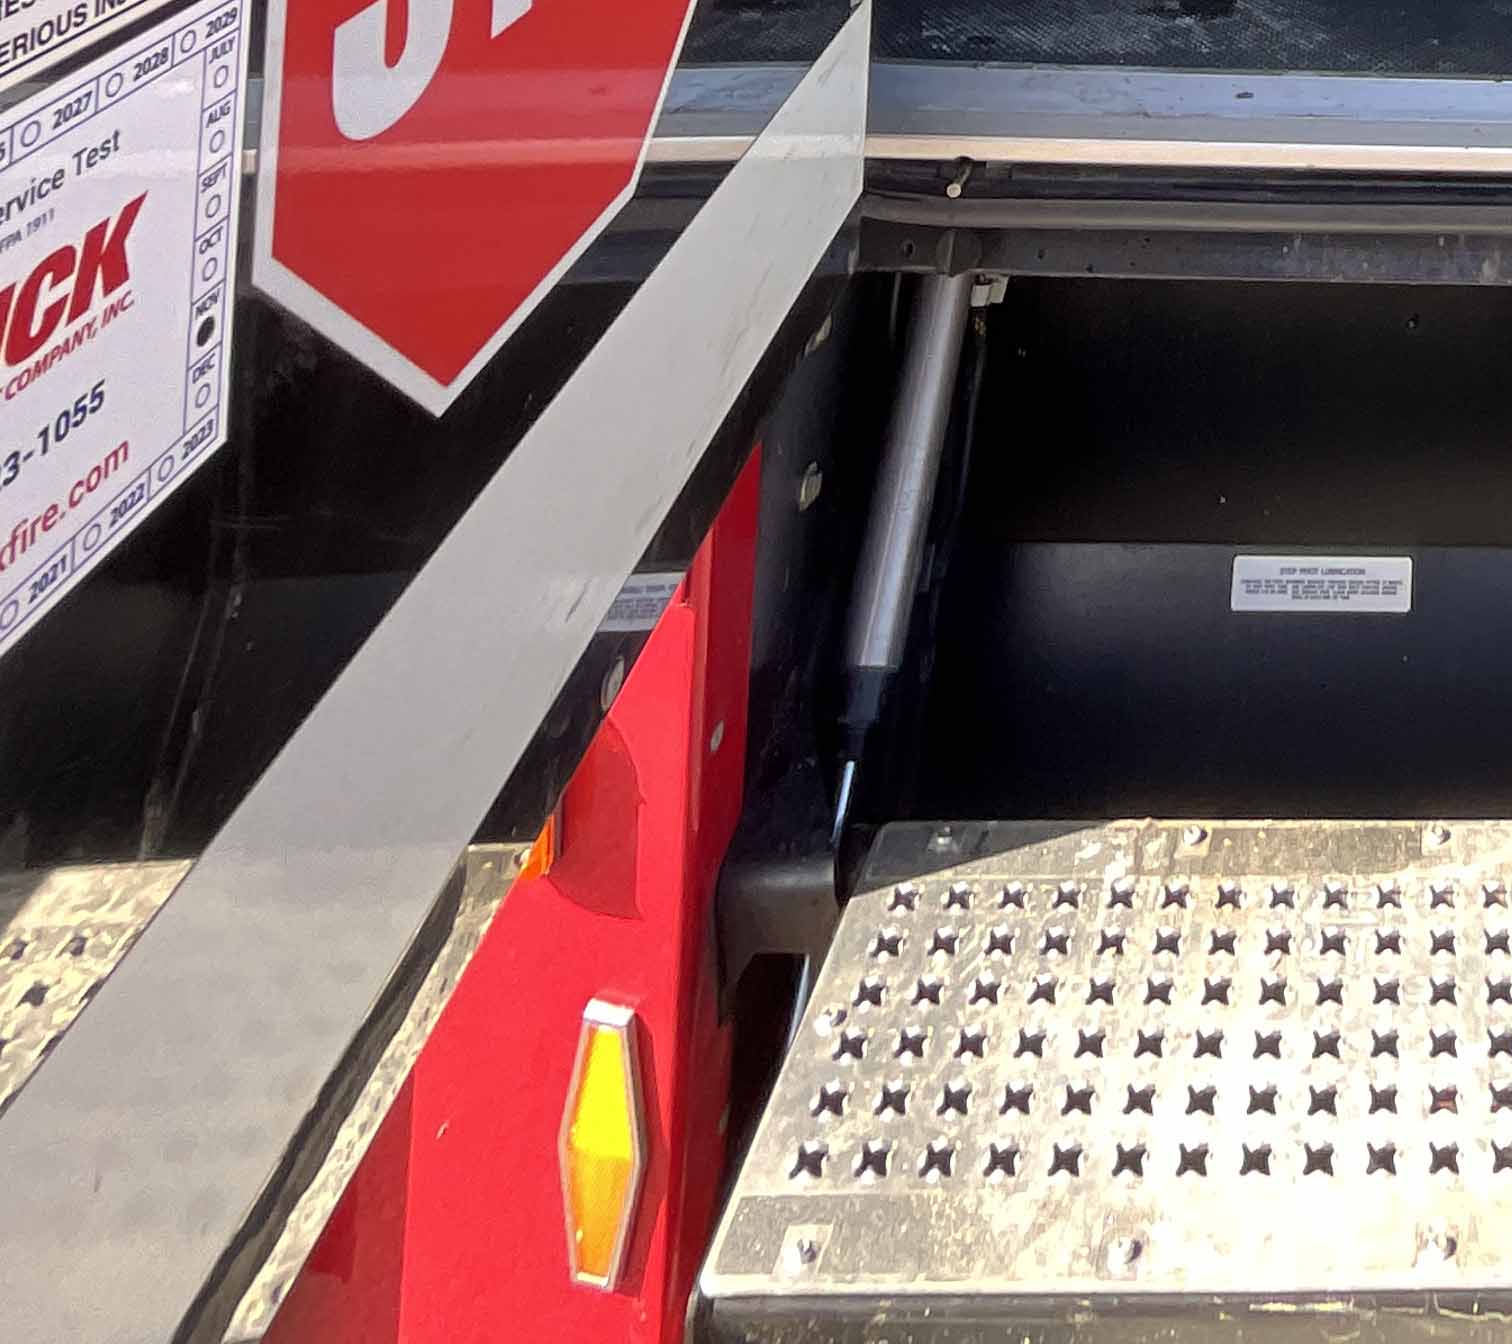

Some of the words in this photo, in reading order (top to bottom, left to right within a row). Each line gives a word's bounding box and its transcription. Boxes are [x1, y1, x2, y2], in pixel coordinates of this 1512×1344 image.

[208, 35, 236, 64] JULY
[52, 89, 94, 130] 2027
[132, 46, 170, 82] 2028
[204, 5, 239, 40] 2029
[205, 99, 232, 129] AUG
[71, 129, 121, 177] Test
[201, 161, 229, 194] SEPT
[26, 206, 56, 238] 1911
[199, 225, 224, 255] OCT
[5, 315, 98, 401] COMPANY,
[101, 289, 135, 329] INC
[192, 352, 216, 385] DEC
[28, 554, 68, 604] 2021
[109, 482, 146, 529] 2022
[181, 418, 215, 461] 2023
